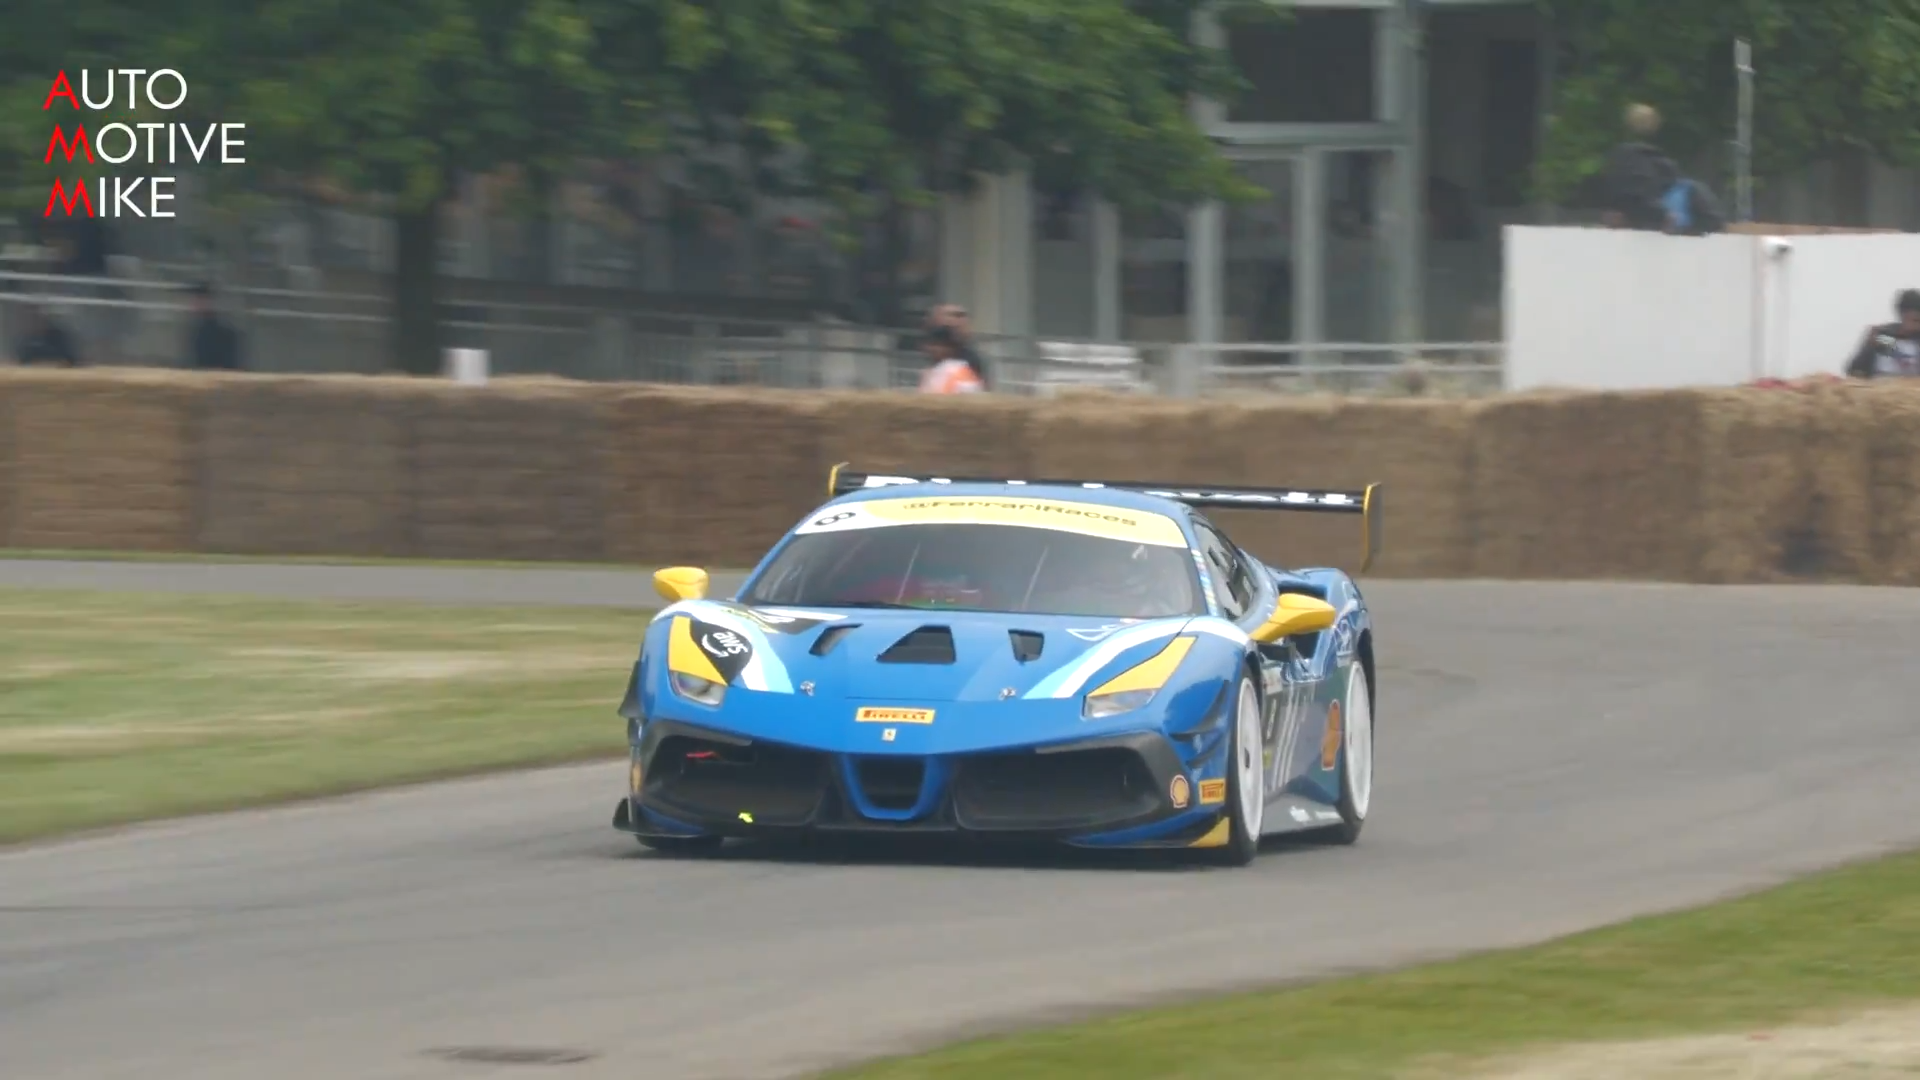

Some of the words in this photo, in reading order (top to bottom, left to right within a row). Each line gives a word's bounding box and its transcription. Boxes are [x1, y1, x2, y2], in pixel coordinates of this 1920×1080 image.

[814, 511, 856, 527] 8
[903, 501, 1137, 527] @FerrariRaces
[713, 630, 749, 656] aws
[862, 709, 928, 721] PIRELLI
